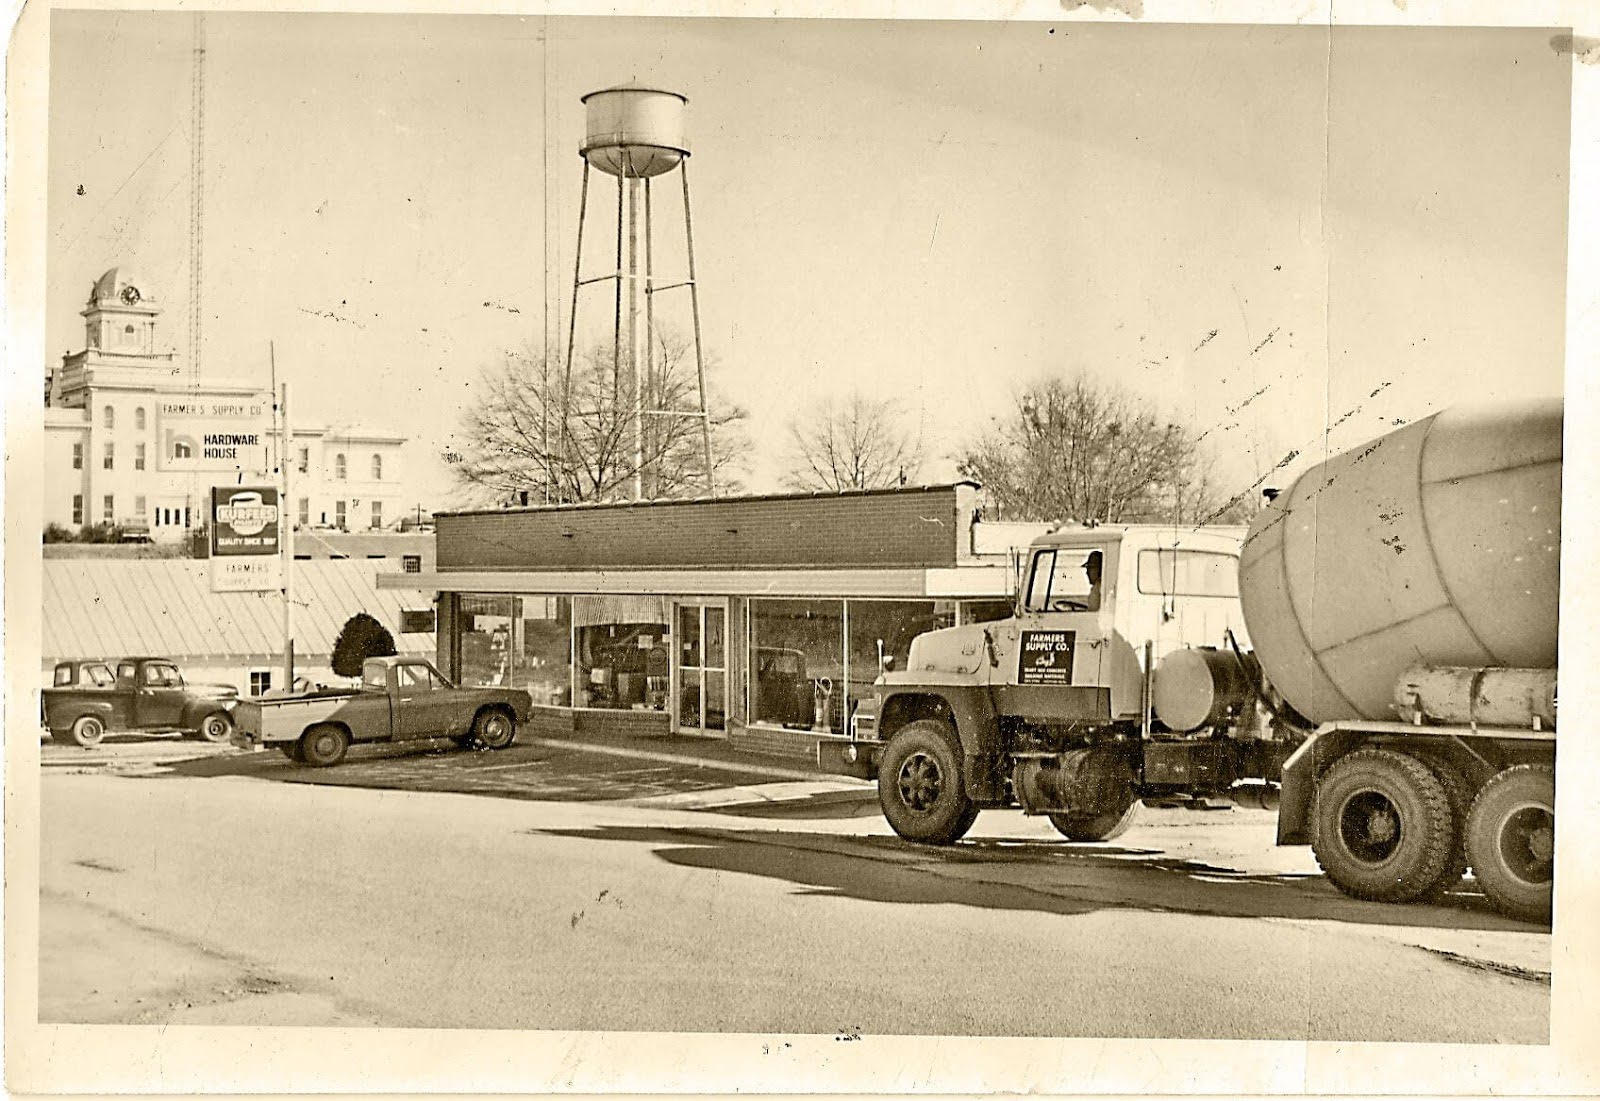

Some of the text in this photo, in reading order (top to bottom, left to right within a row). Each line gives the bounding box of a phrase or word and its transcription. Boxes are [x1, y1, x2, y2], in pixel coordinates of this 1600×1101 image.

[212, 405, 244, 415] SUPPLY
[204, 434, 259, 446] HARDWARE
[204, 447, 238, 459] HOUSE
[218, 537, 244, 546] QUALITY
[244, 537, 261, 546] SINCE
[1030, 634, 1065, 642] FARMERS
[1025, 642, 1070, 651] SUPPLY CO.
